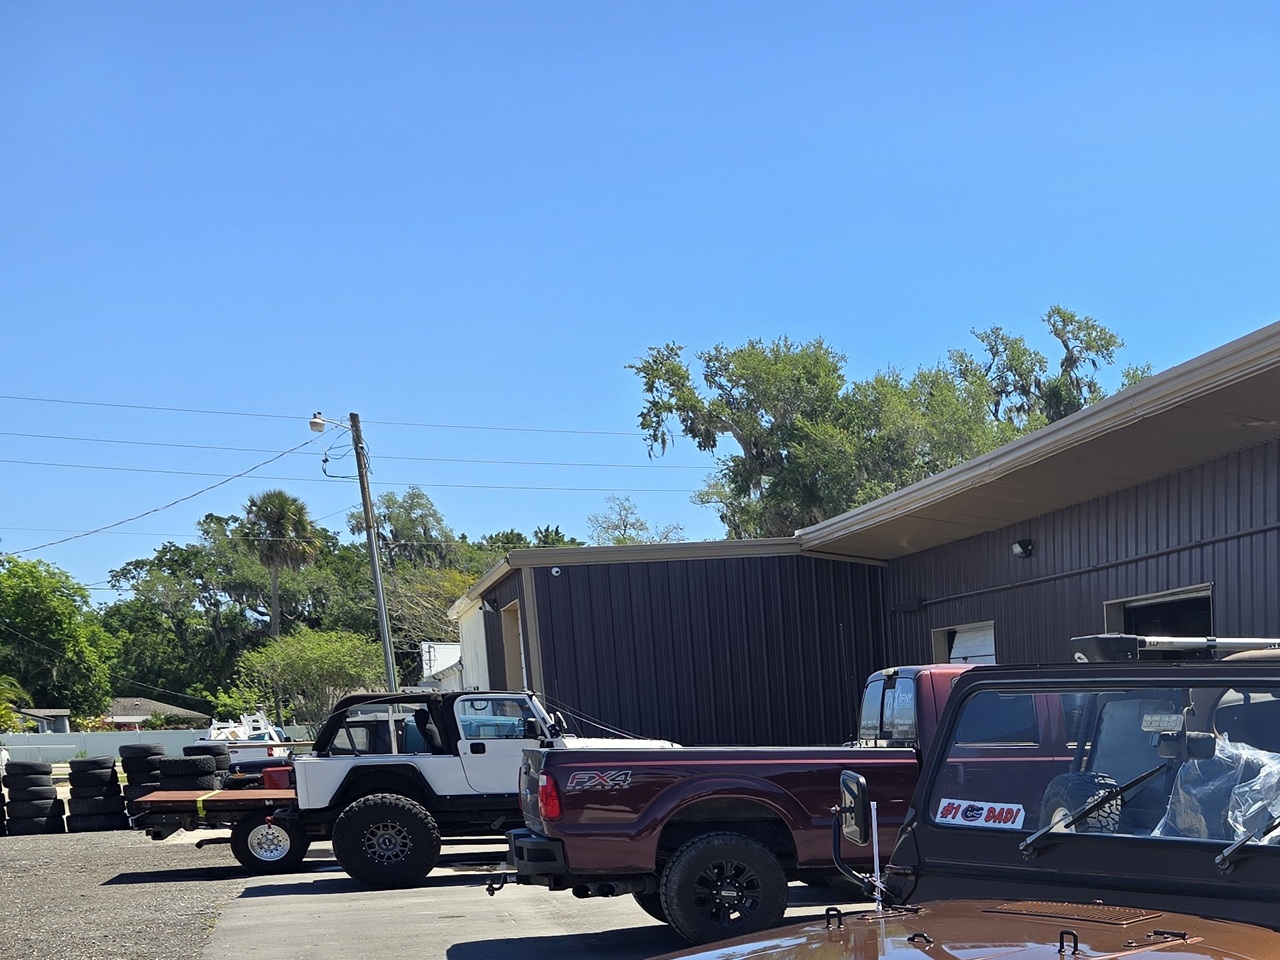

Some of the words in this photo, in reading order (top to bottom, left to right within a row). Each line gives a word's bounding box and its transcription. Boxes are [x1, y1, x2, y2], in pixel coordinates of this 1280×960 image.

[566, 770, 632, 786] FX4
[940, 802, 961, 820] #1
[984, 806, 1021, 825] DAD!
